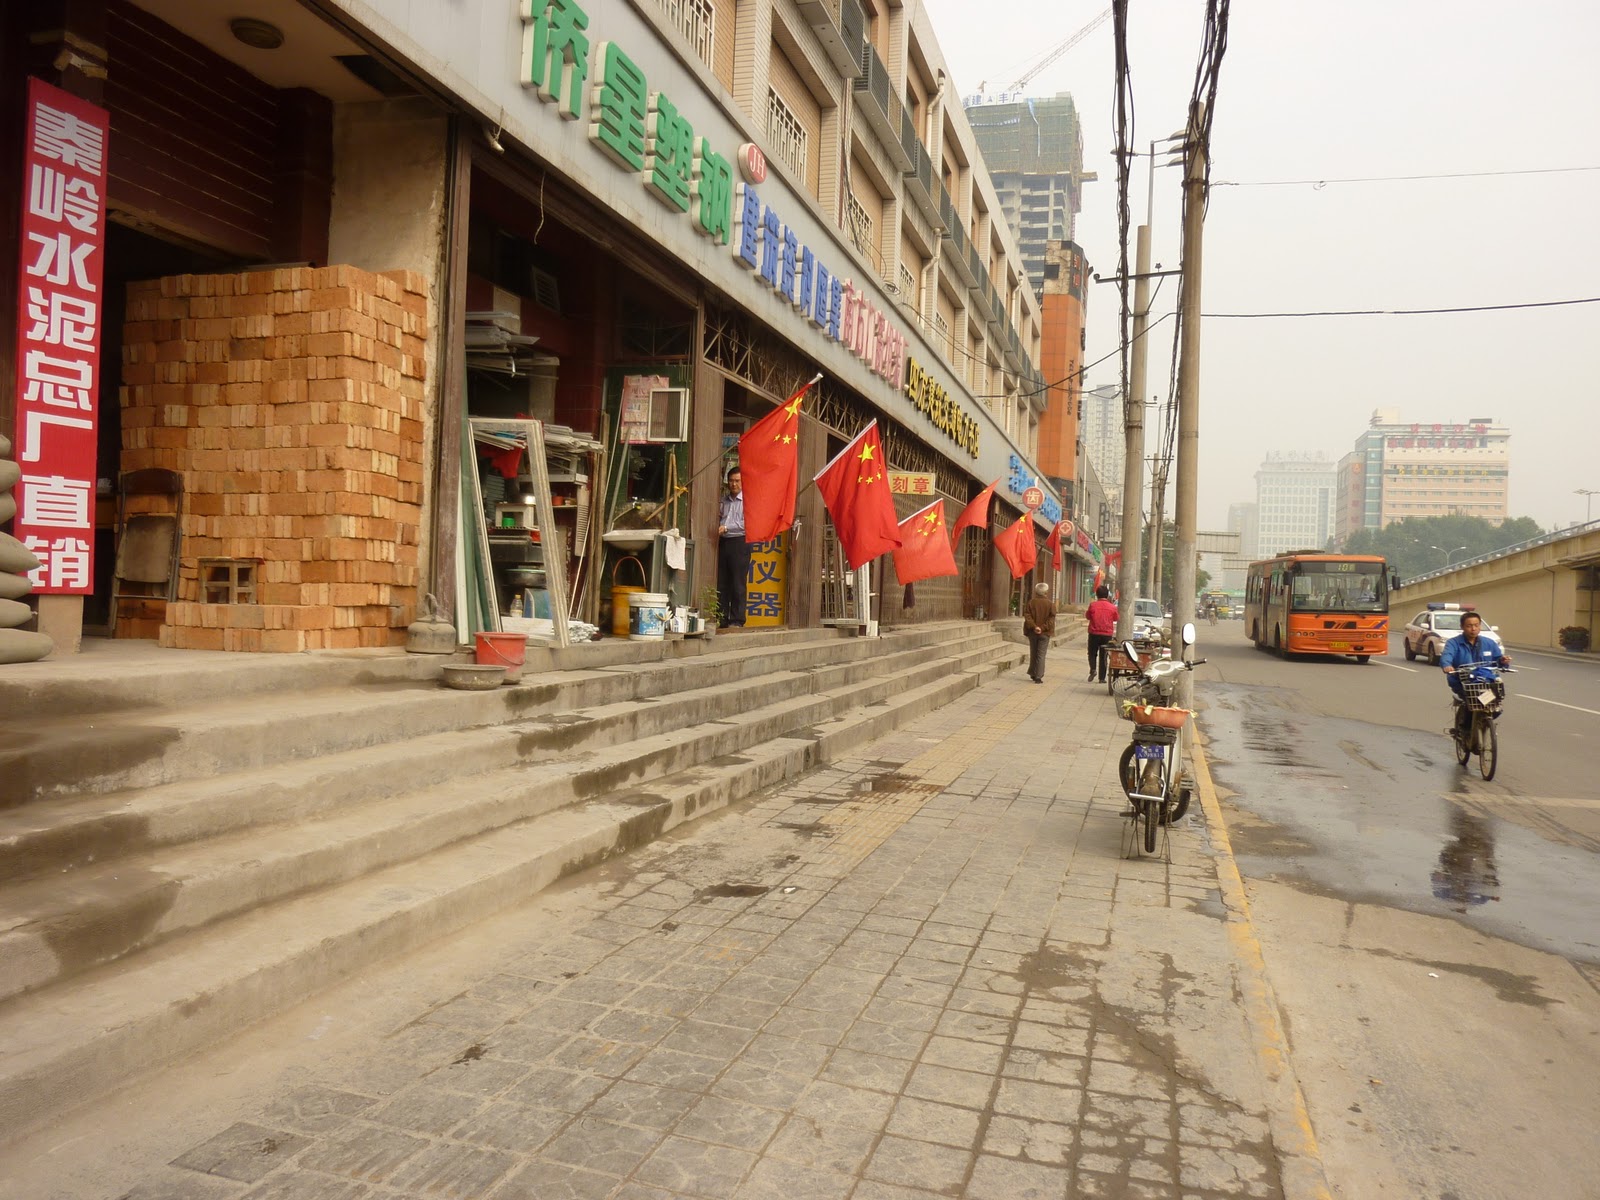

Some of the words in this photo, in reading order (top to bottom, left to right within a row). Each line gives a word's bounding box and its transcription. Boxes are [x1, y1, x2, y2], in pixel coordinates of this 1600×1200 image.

[750, 147, 766, 179] JH
[21, 102, 104, 589] 秦岭水泥总厂直销
[892, 476, 930, 494] 刻章
[1026, 491, 1040, 504] 齿
